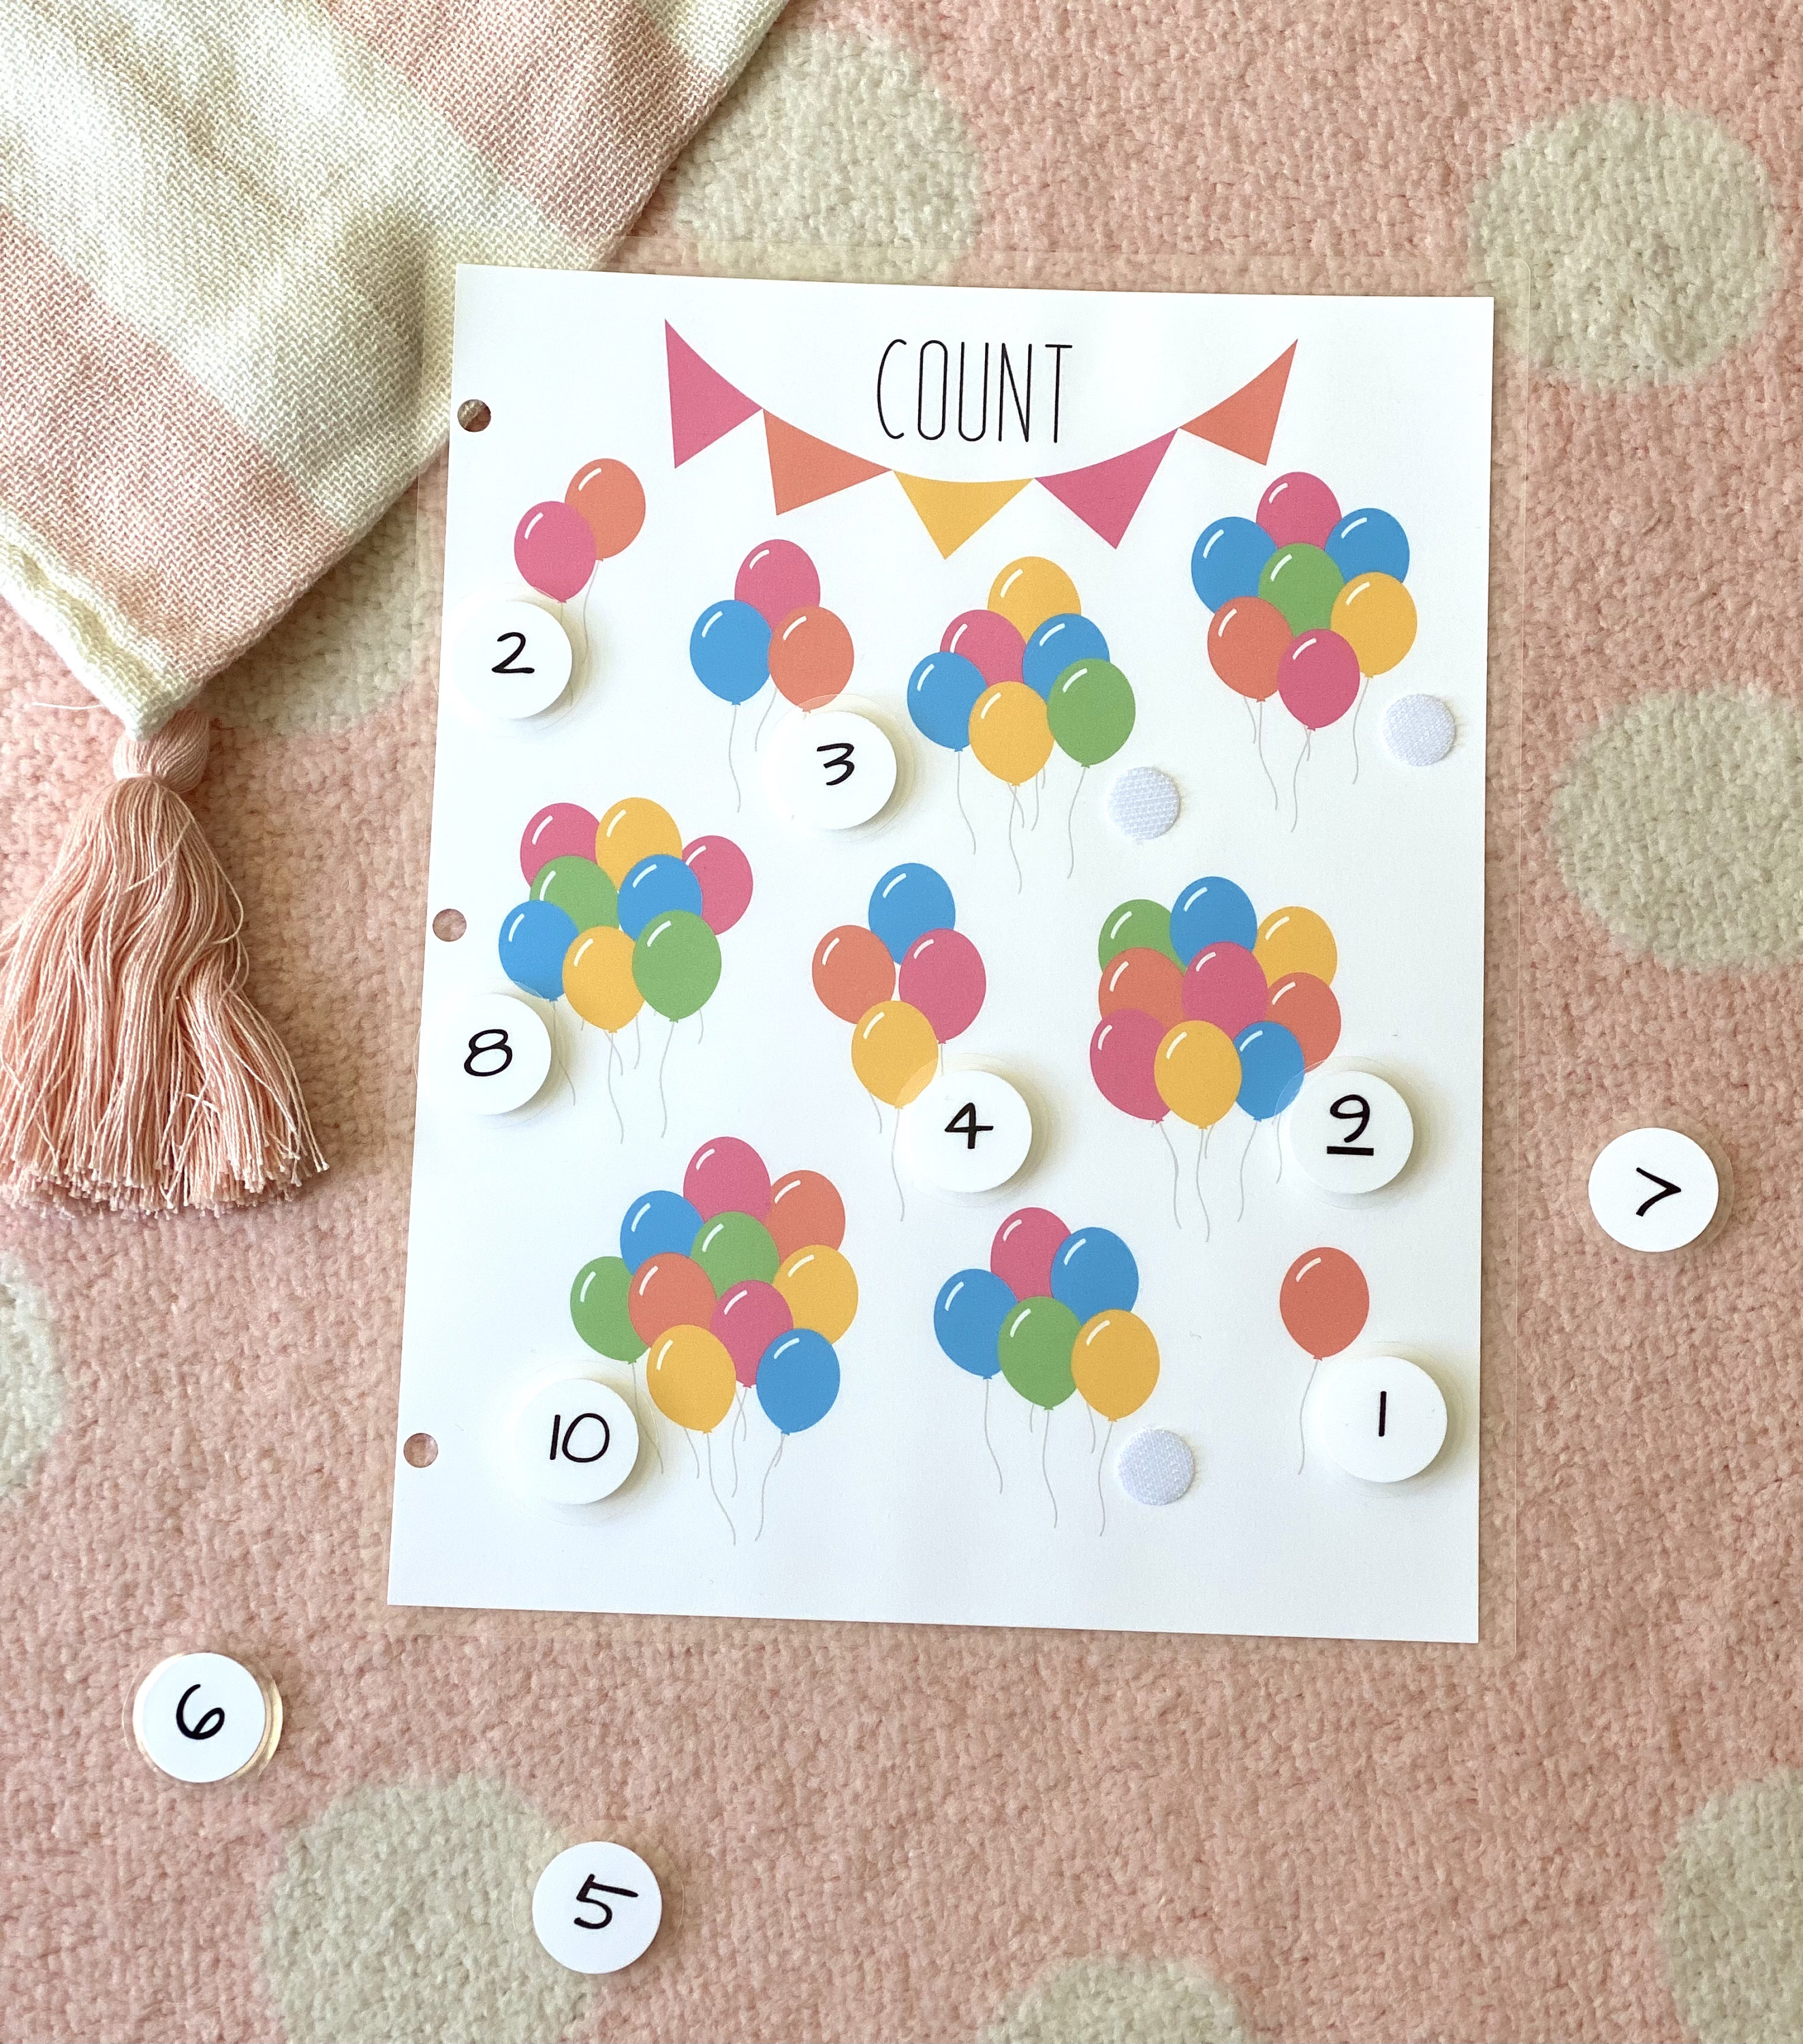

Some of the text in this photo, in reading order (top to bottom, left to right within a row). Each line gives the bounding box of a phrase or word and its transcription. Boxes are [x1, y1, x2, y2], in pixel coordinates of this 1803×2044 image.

[877, 339, 1073, 444] COUNT
[491, 632, 535, 674] 2
[816, 743, 855, 786] 3
[463, 1029, 513, 1077] 8
[944, 1102, 994, 1149] 4
[1328, 1094, 1373, 1147] 9
[1635, 1167, 1682, 1217] 7
[549, 1412, 610, 1464] 10
[1377, 1390, 1387, 1438] 1
[176, 1684, 225, 1740] 6
[574, 1874, 639, 1930] 5
